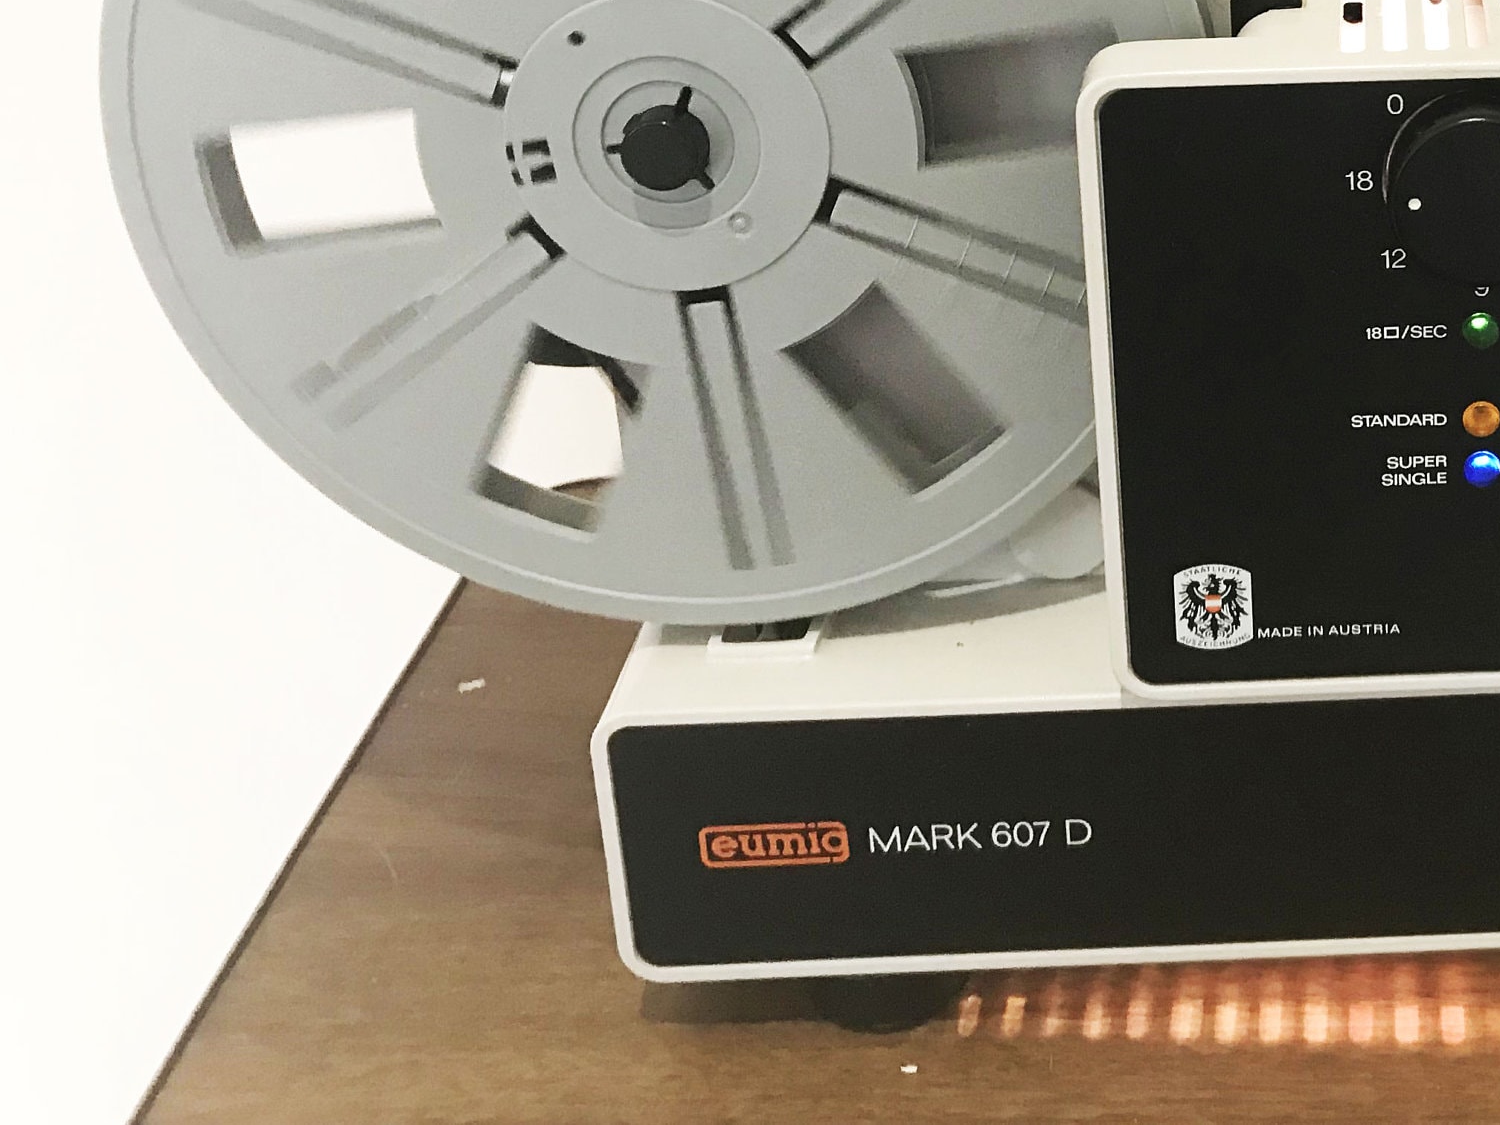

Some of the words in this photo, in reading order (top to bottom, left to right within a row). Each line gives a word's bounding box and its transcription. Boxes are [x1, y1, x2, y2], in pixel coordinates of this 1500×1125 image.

[1386, 93, 1404, 115] 0
[1345, 170, 1374, 192] 18
[1380, 248, 1407, 269] 12
[1350, 413, 1448, 428] STANDARD
[1386, 454, 1447, 469] SUPER
[1381, 471, 1448, 487] SINGLE
[1257, 626, 1303, 639] MADE
[1307, 625, 1324, 637] IN
[1328, 623, 1401, 636] AUSTRIA
[704, 821, 850, 862] eumig
[868, 822, 983, 854] MARK
[991, 820, 1051, 848] 607
[1064, 818, 1092, 846] D
